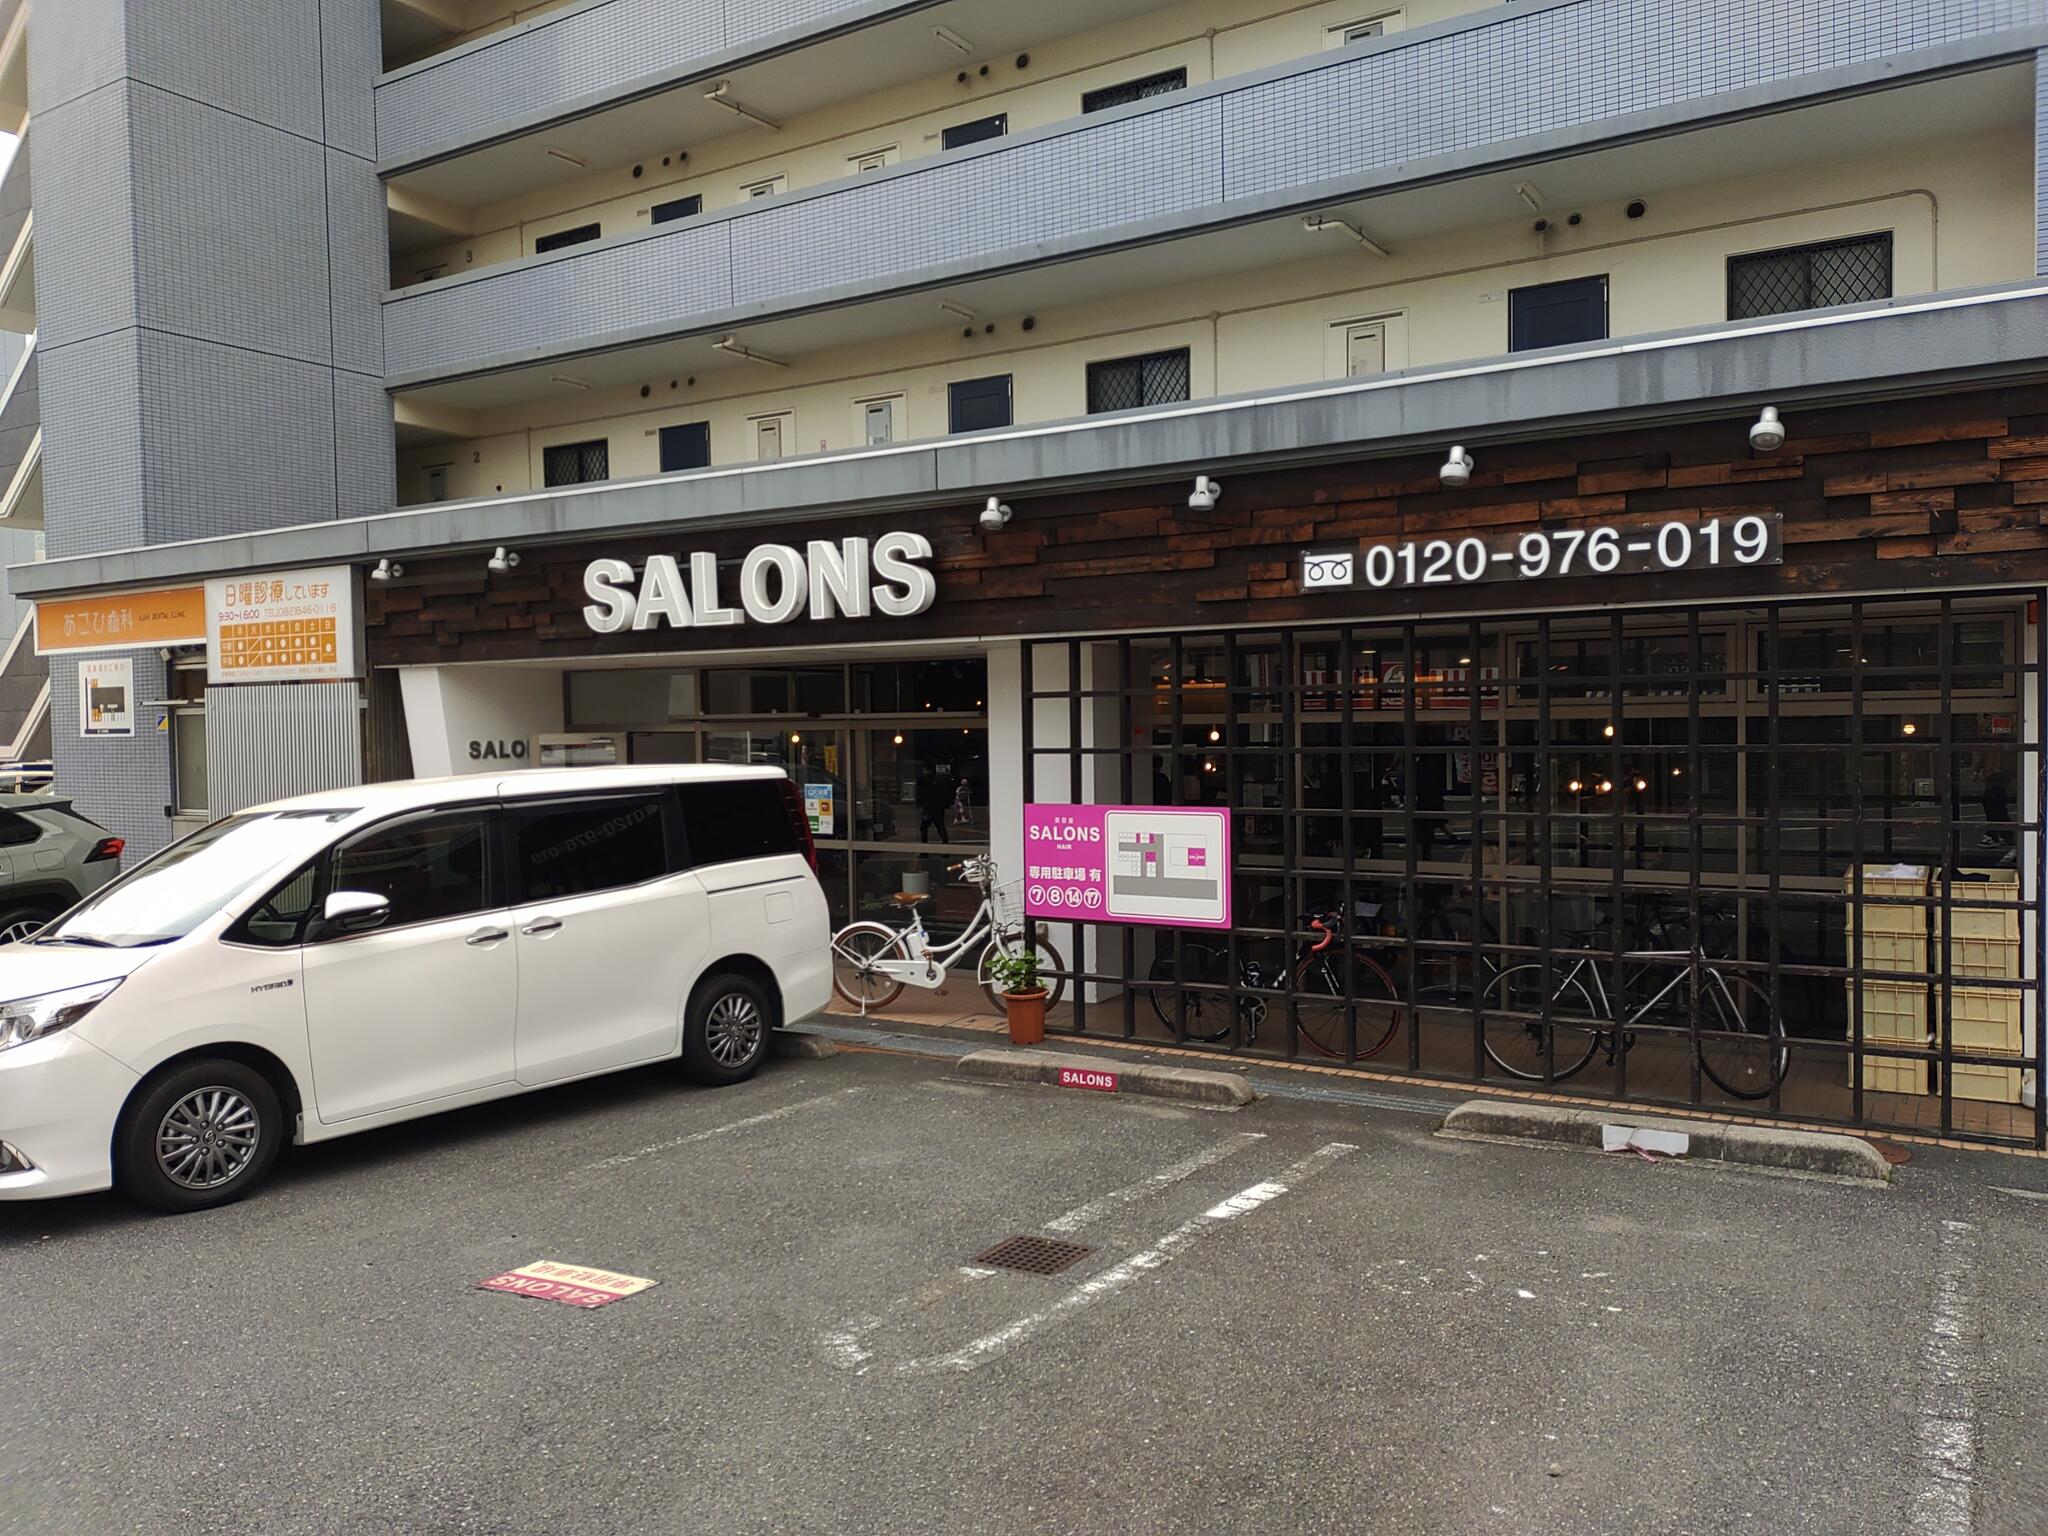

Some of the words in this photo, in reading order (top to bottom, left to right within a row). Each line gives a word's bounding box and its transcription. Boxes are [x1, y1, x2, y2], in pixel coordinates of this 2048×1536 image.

[465, 250, 474, 264] 3
[473, 451, 481, 464] 2
[1365, 516, 1768, 587] 0120-976-019
[583, 531, 936, 634] SALONS
[225, 579, 330, 607] 日曜診療しています
[63, 608, 133, 637] あさひ歯科
[468, 740, 530, 760] SALO
[1029, 825, 1101, 842] SALONS
[1029, 866, 1086, 881] 専用駐車場
[1089, 868, 1101, 882] 有
[1063, 1071, 1113, 1087] SALONS
[489, 1275, 612, 1304] SALONS
